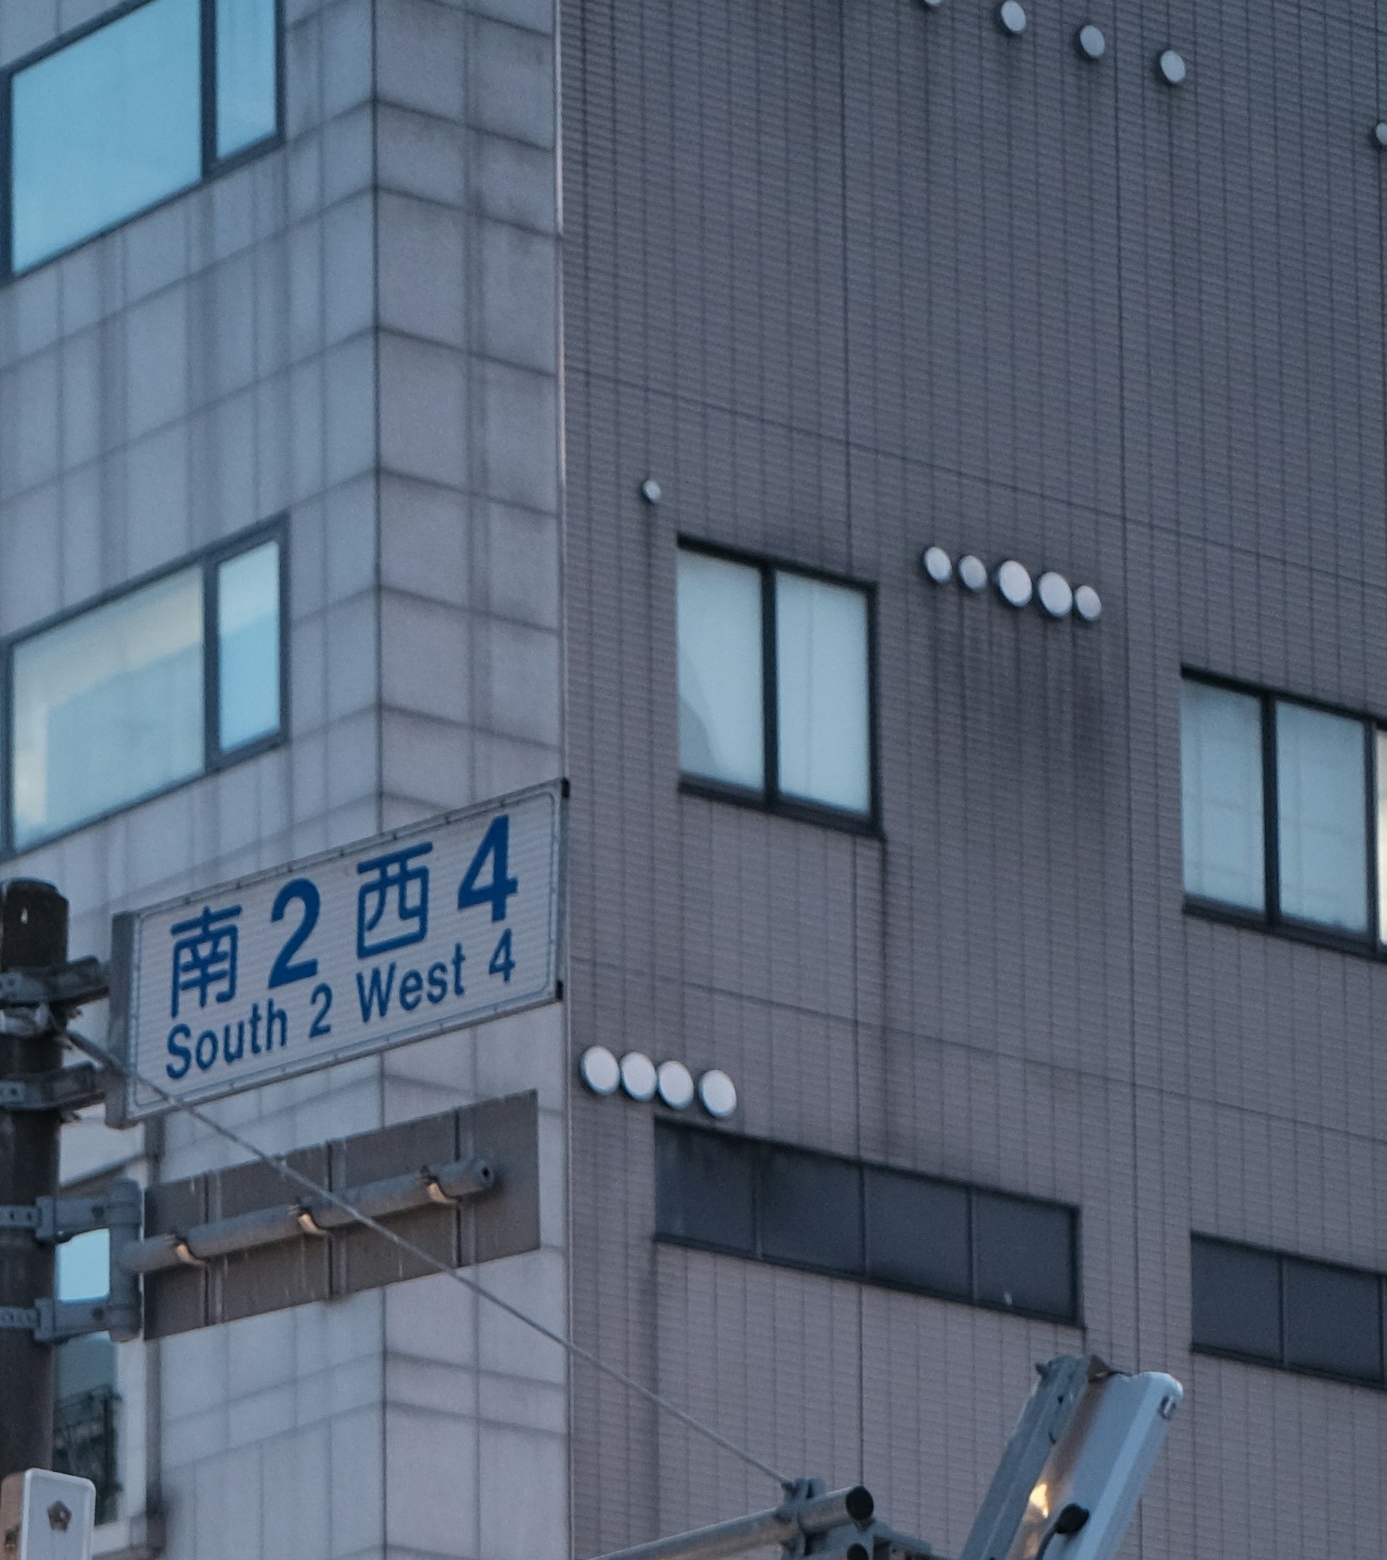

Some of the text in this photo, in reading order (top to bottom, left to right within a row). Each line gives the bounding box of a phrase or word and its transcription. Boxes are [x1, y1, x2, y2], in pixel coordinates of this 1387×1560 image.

[166, 929, 516, 1081] South 2 West 4
